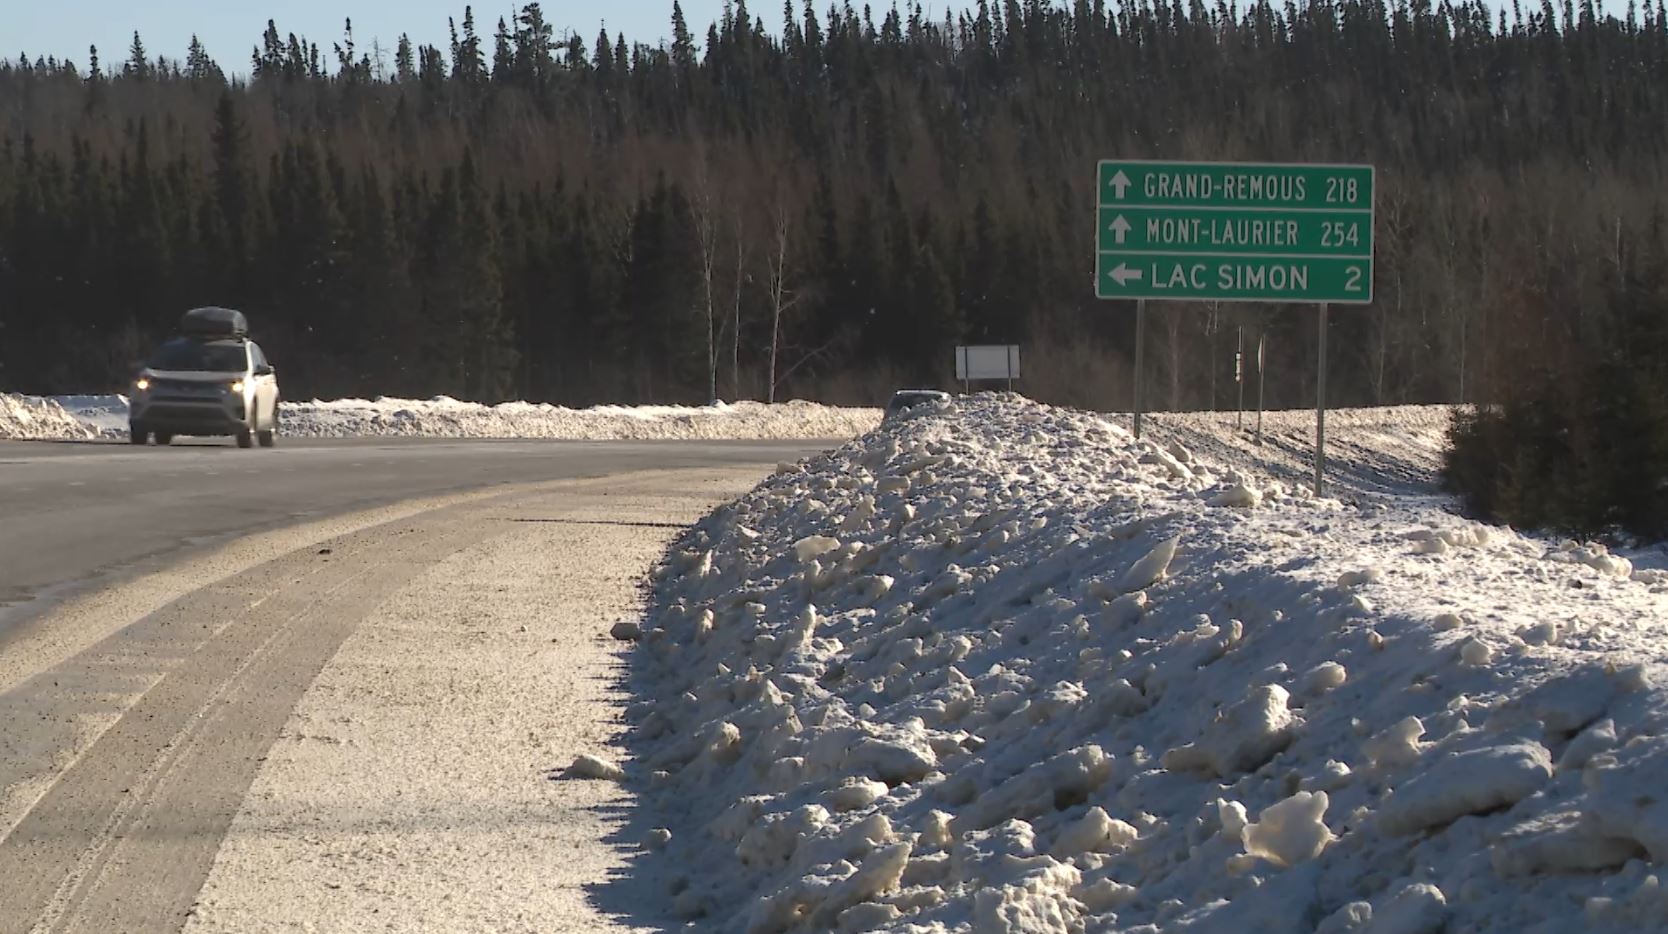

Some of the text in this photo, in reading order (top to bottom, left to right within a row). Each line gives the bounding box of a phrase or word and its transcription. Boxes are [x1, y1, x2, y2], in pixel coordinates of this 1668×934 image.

[1144, 173, 1358, 203] GRAND-REMOUS 218
[1146, 218, 1359, 247] MONT-LAURIER 254
[1151, 263, 1361, 291] LAC SIMON 2
